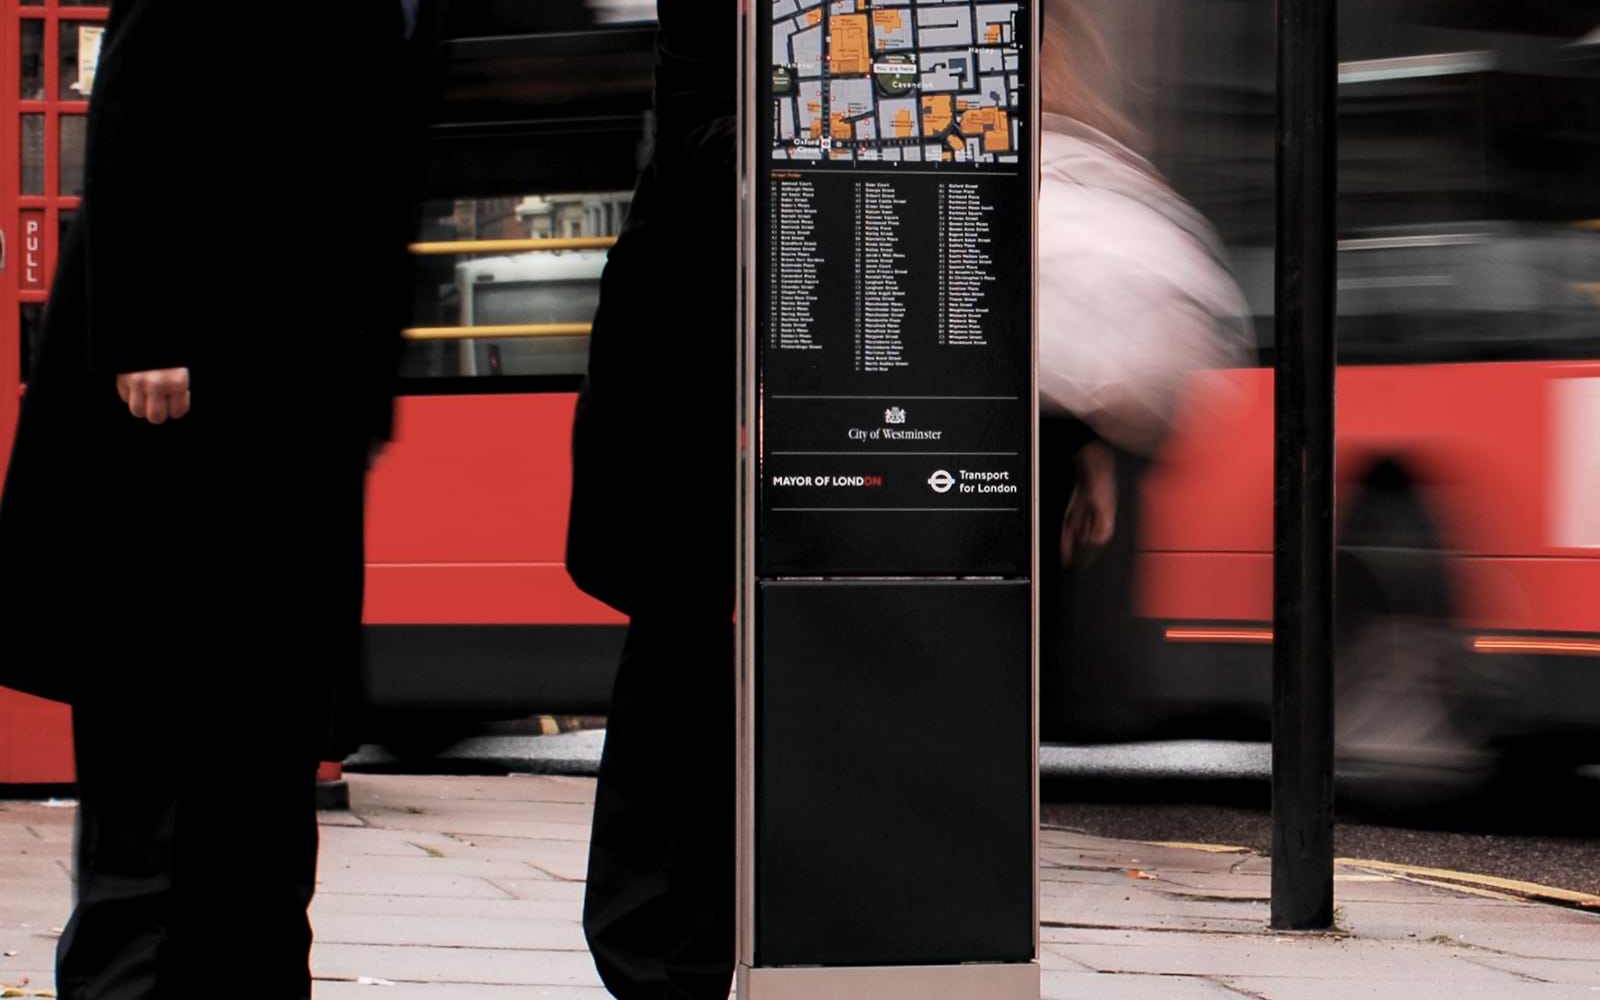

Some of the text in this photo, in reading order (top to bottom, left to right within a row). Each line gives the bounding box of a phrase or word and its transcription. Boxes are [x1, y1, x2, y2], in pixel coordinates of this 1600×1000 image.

[27, 221, 38, 282] PULL
[848, 428, 942, 442] City of Westminster
[773, 476, 882, 486] MAYOR OF LONDON
[959, 470, 1009, 481] Transport
[959, 483, 1017, 493] for London
